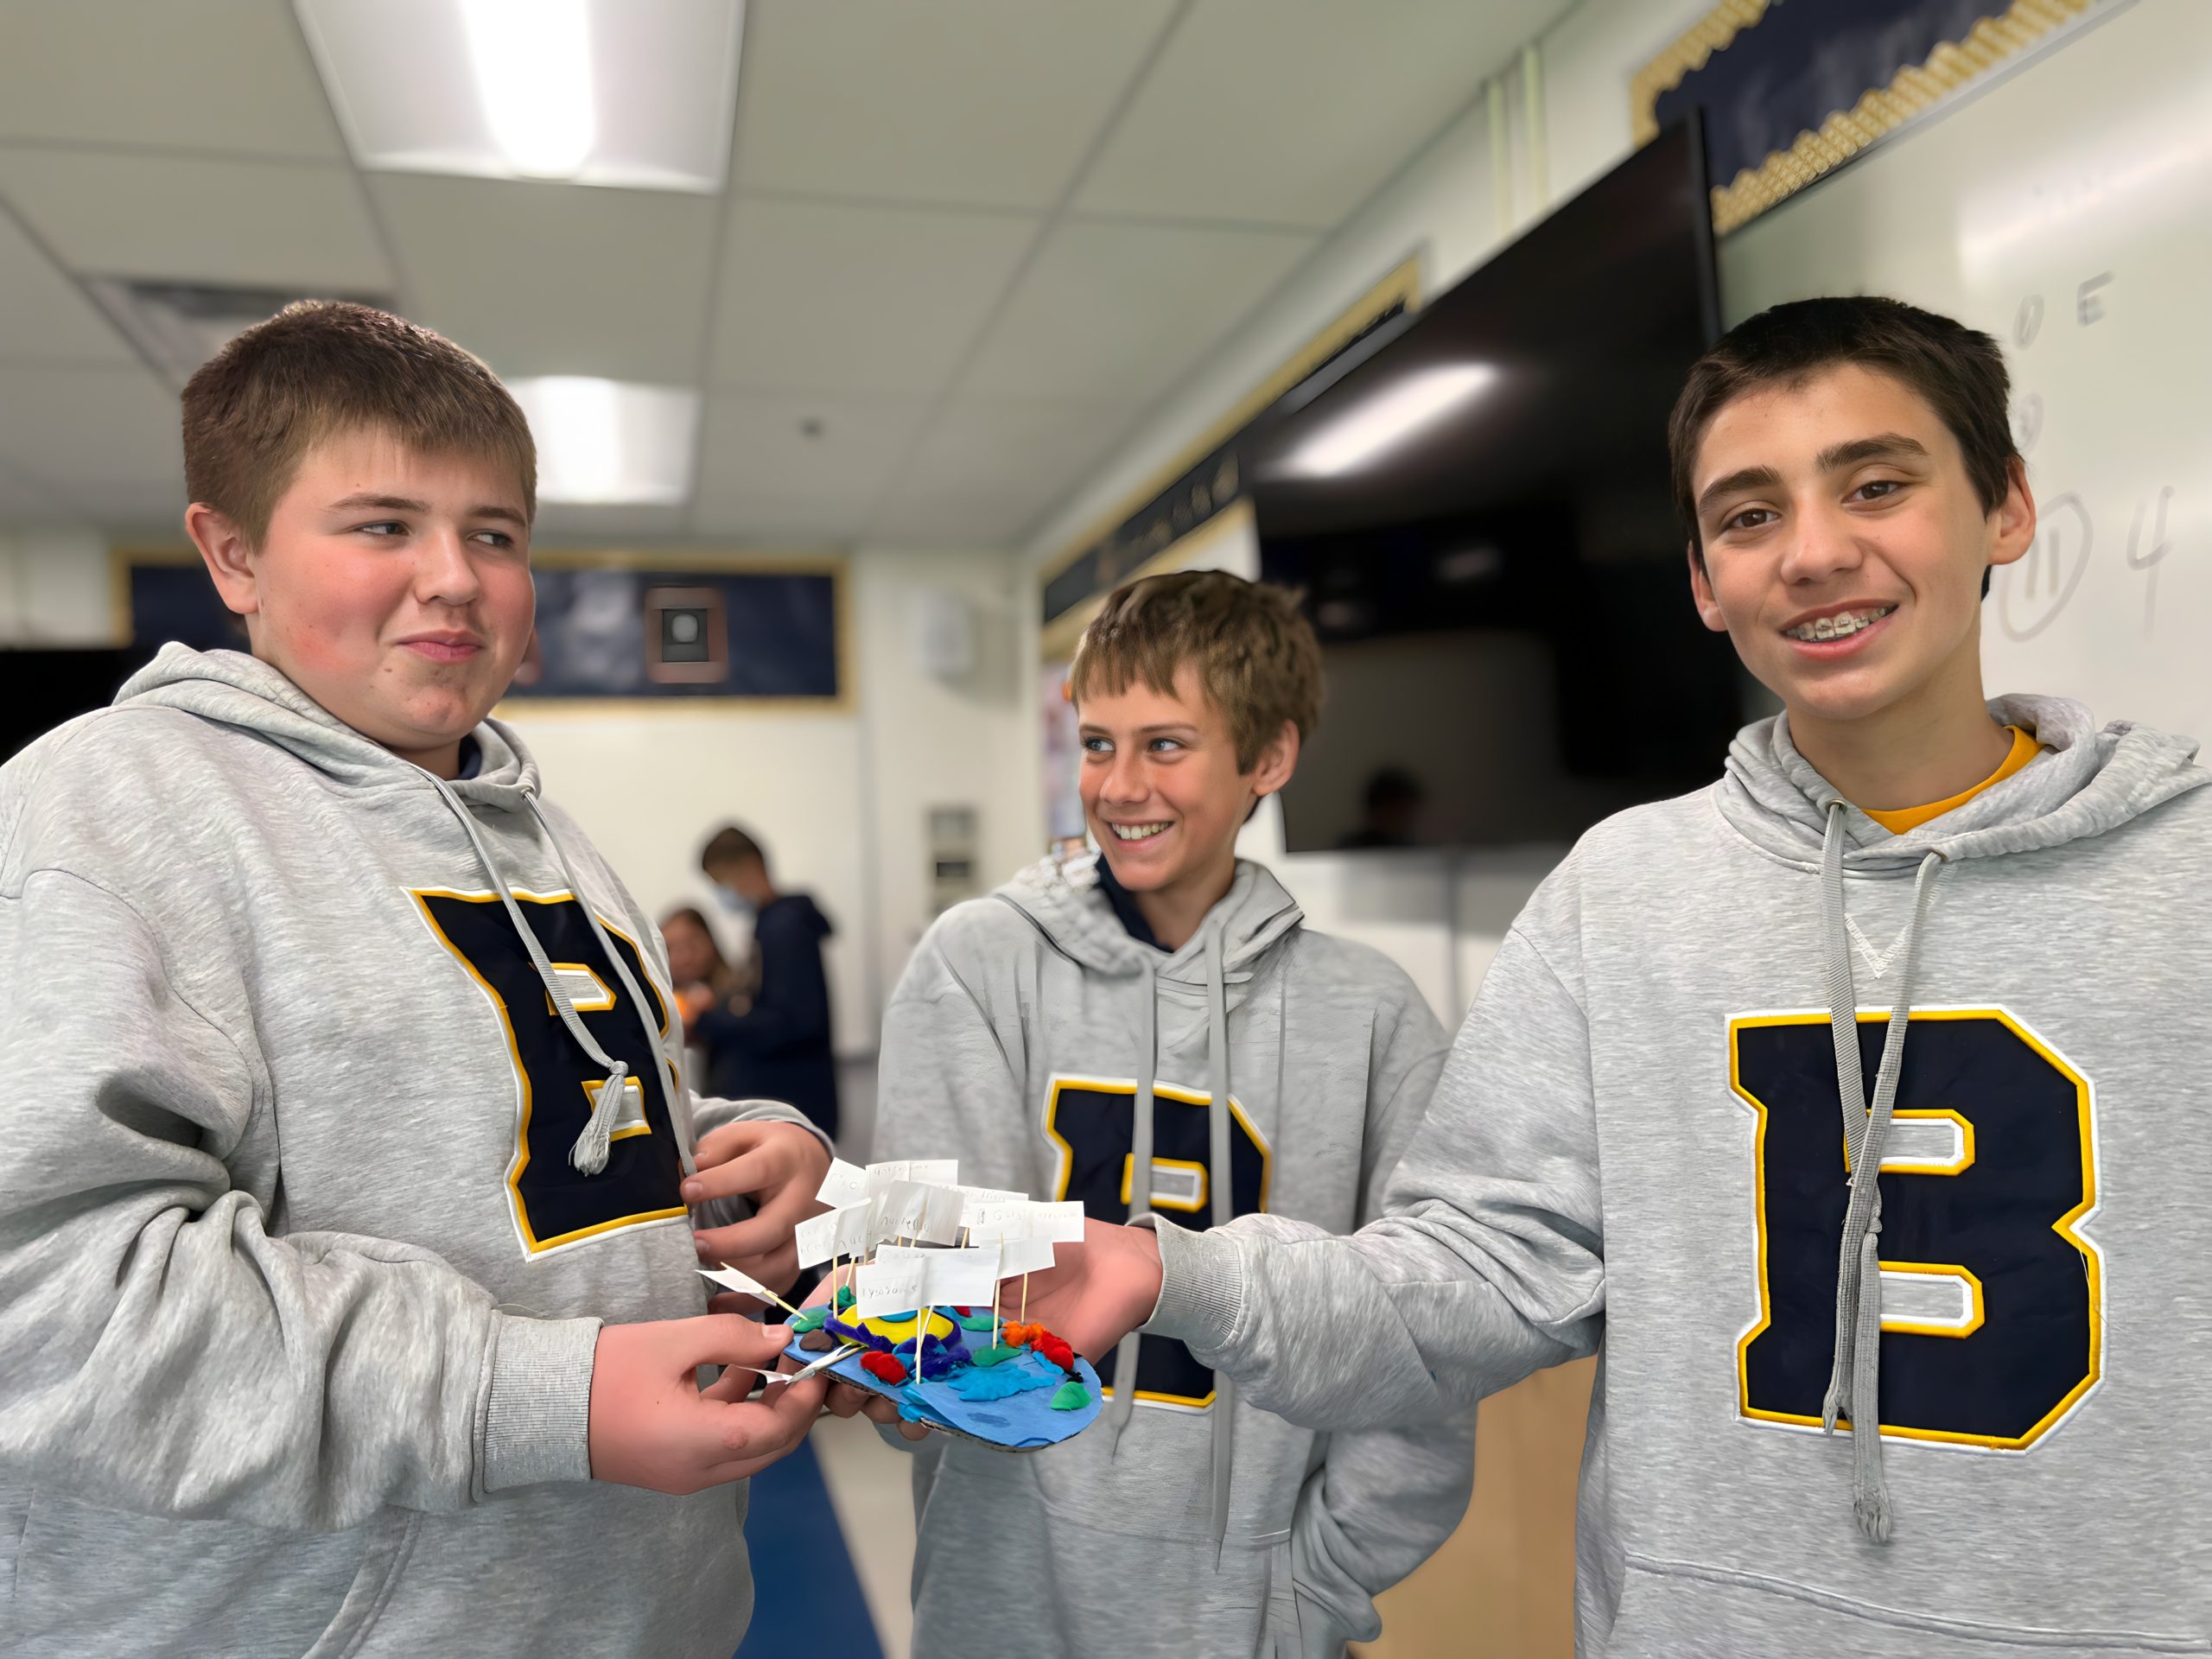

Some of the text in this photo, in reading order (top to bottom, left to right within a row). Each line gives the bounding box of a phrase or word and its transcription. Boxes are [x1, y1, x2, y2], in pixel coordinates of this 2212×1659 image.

[2126, 484, 2176, 642] 4
[400, 887, 691, 1262] B
[1725, 1003, 2108, 1456] B
